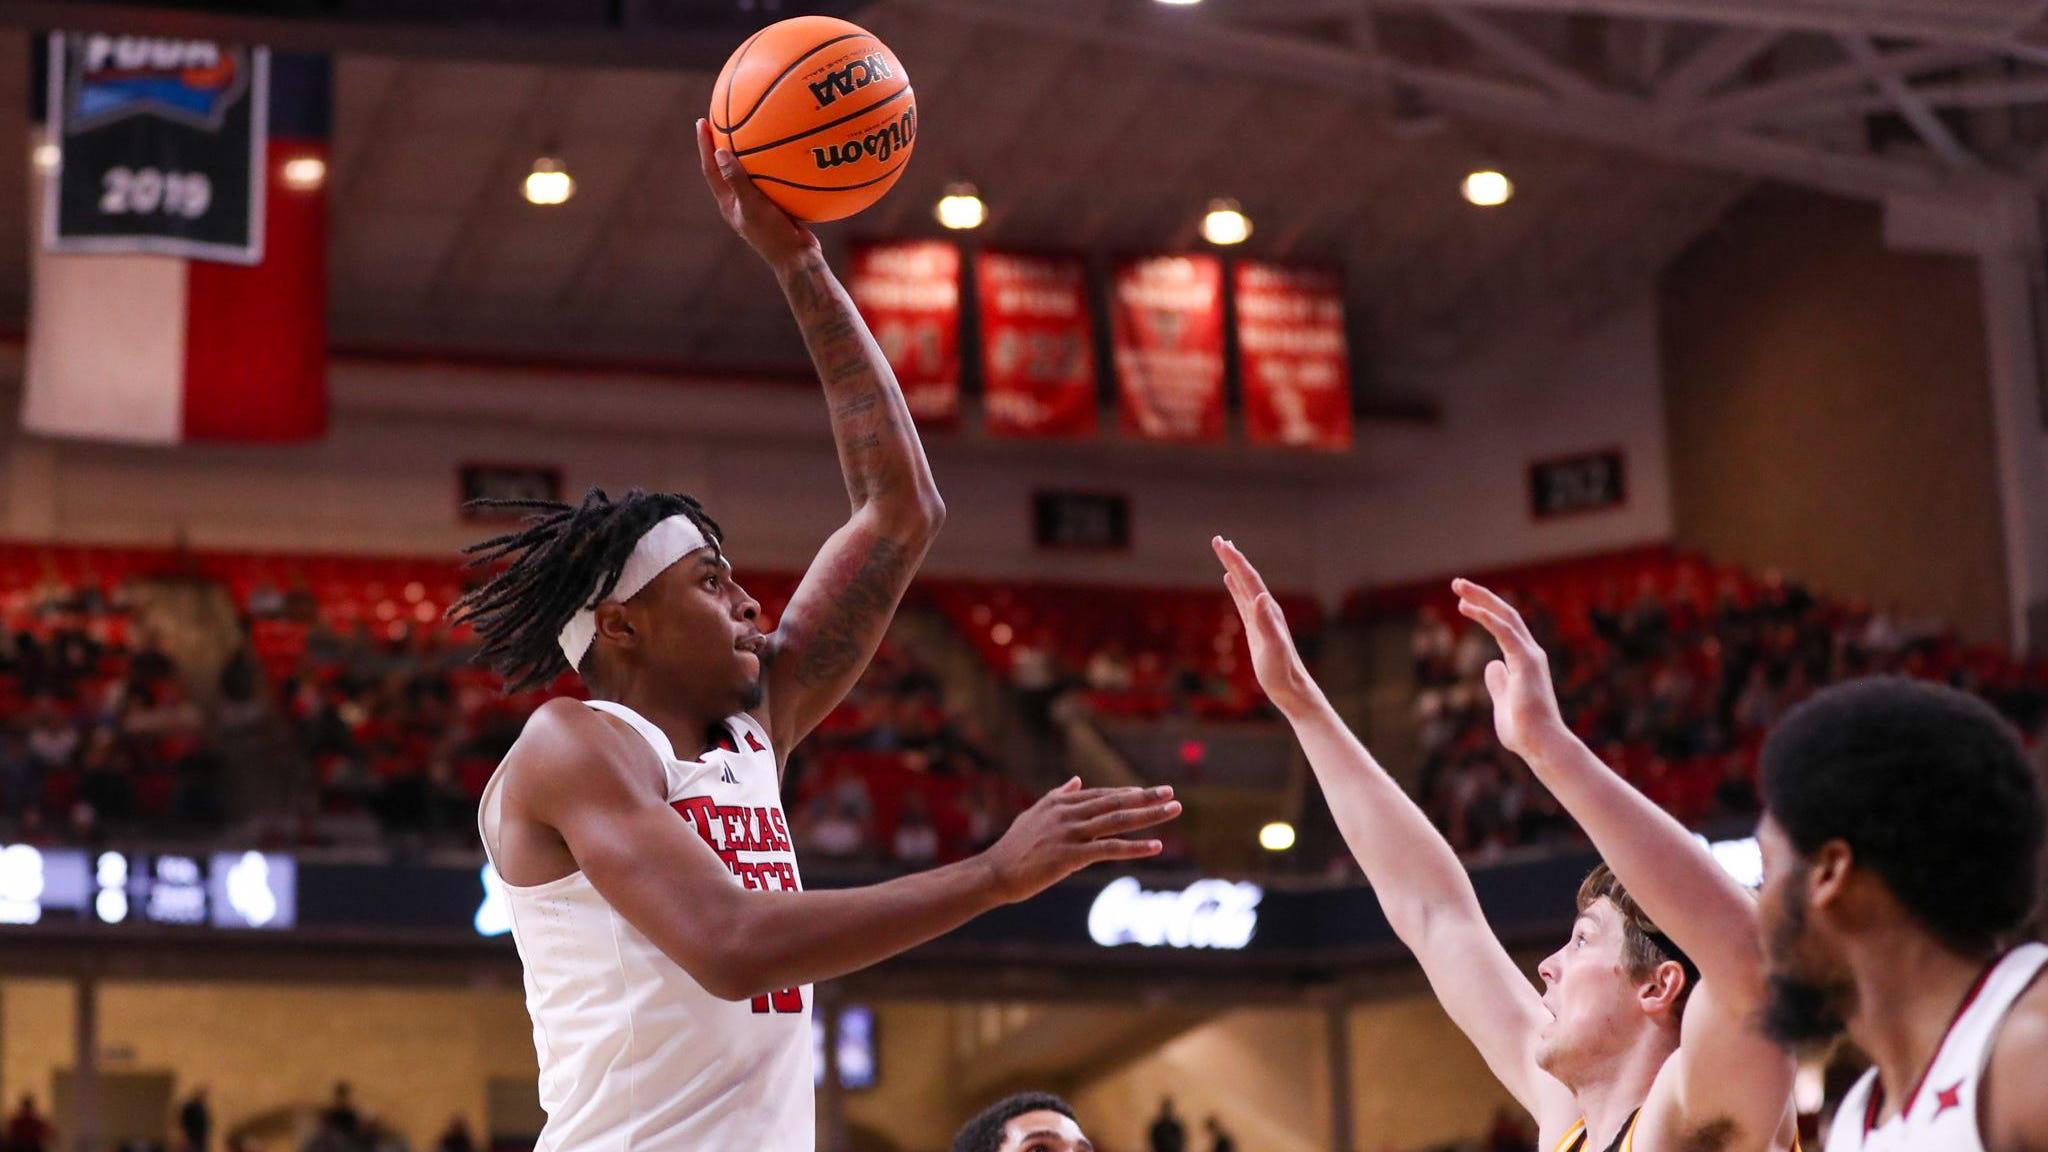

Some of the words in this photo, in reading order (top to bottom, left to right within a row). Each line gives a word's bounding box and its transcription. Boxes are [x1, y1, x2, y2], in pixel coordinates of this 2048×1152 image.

[808, 51, 892, 108] NCAA
[812, 104, 917, 169] Wilson
[100, 165, 212, 218] 2019
[670, 795, 791, 852] TEXAS
